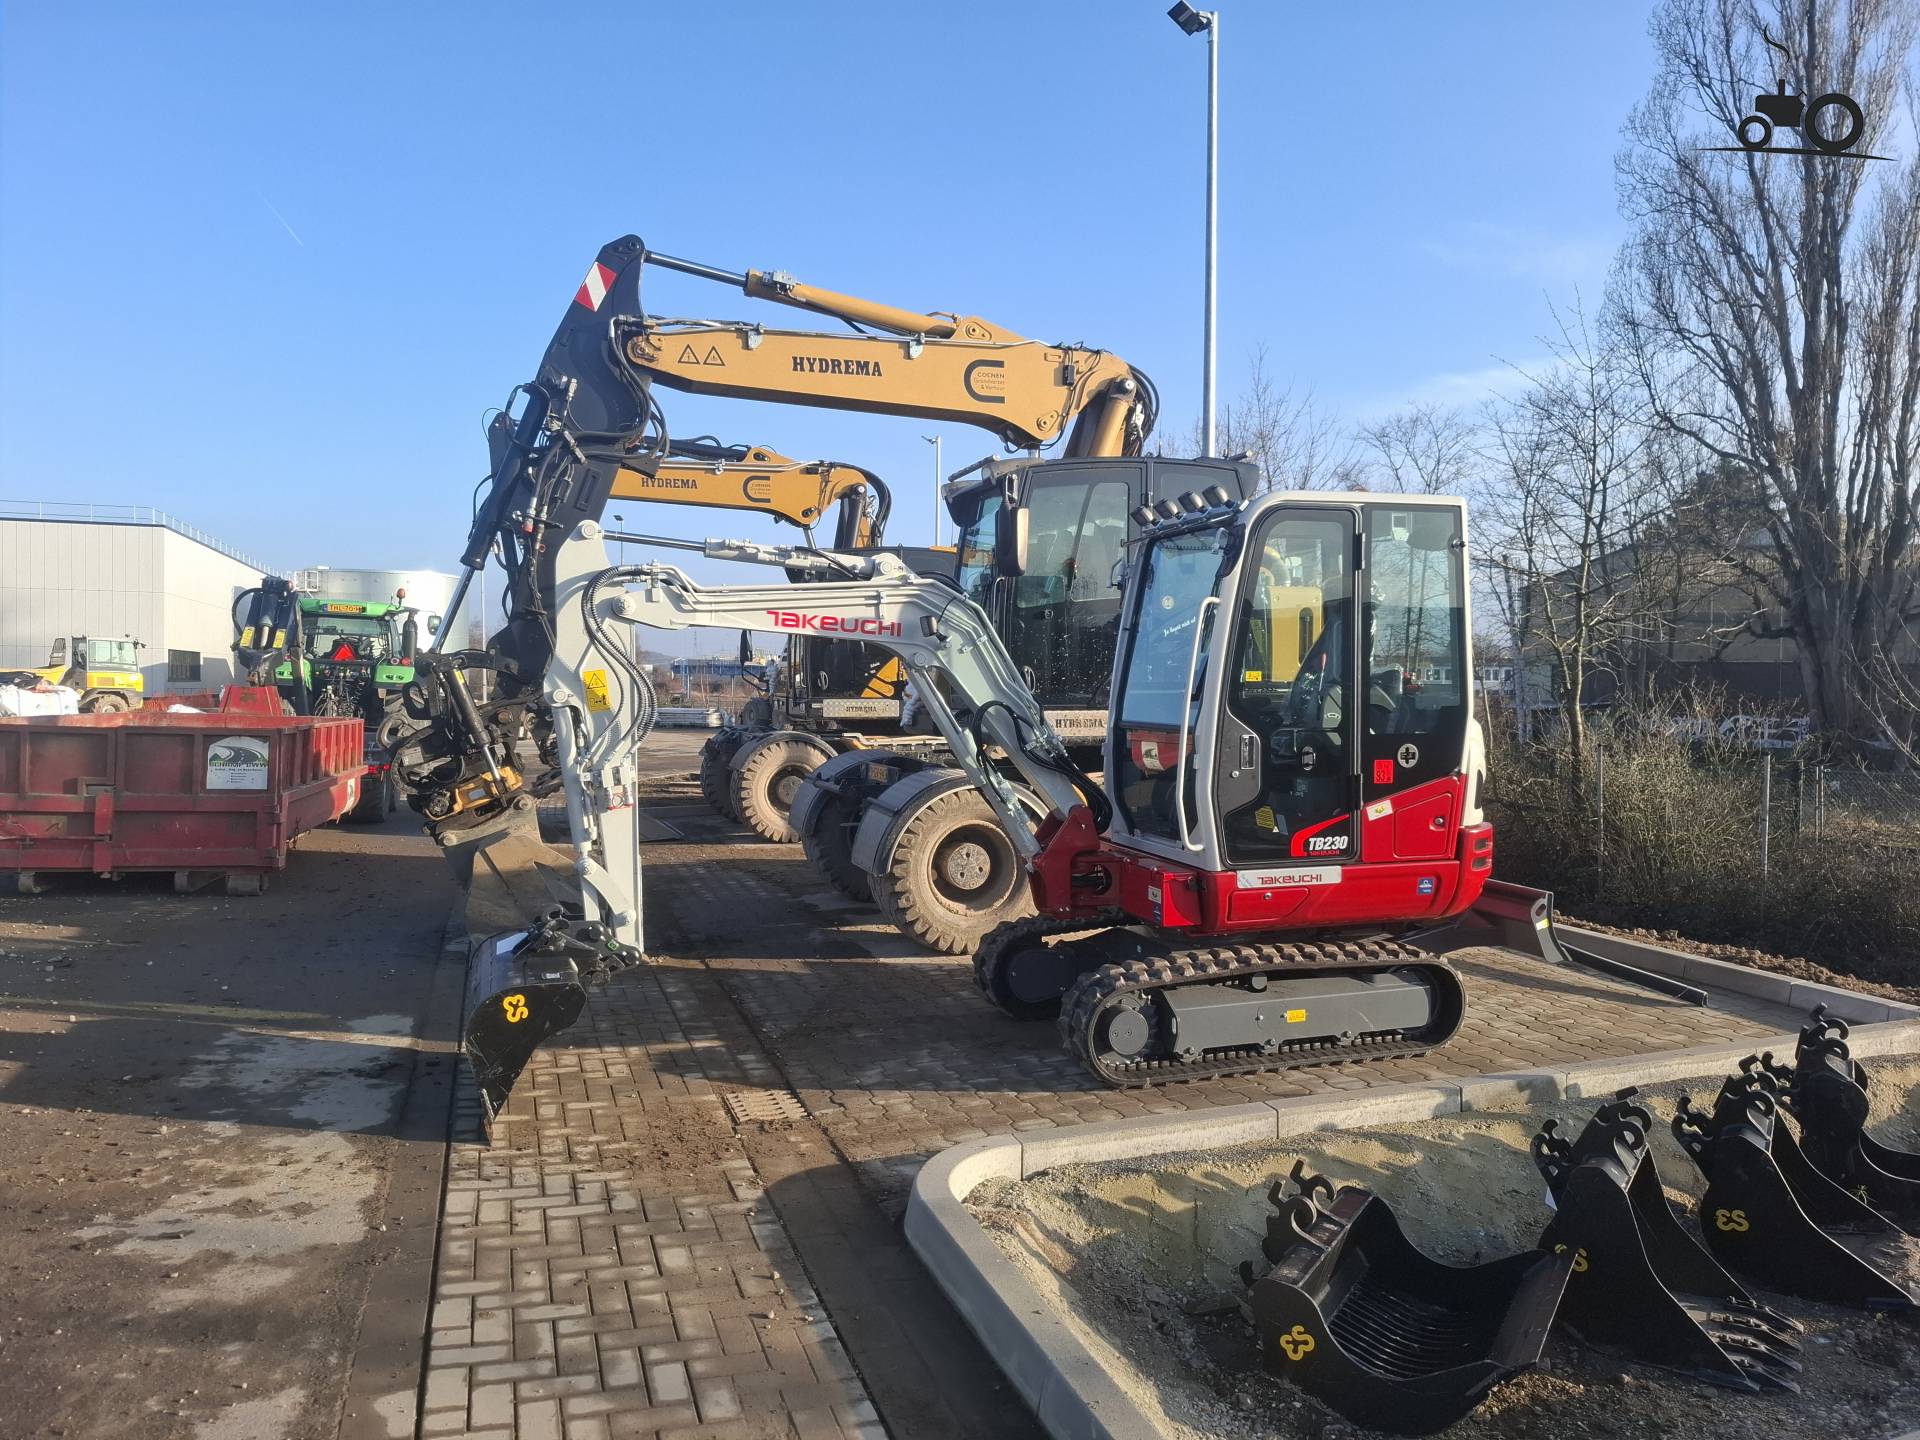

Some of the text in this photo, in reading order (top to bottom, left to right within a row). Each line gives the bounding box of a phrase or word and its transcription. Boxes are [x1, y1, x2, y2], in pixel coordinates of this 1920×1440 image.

[792, 356, 882, 376] HYDREMA
[641, 477, 698, 489] HYDREMA
[1055, 718, 1105, 729] HYDREMA
[1308, 836, 1349, 851] TB230
